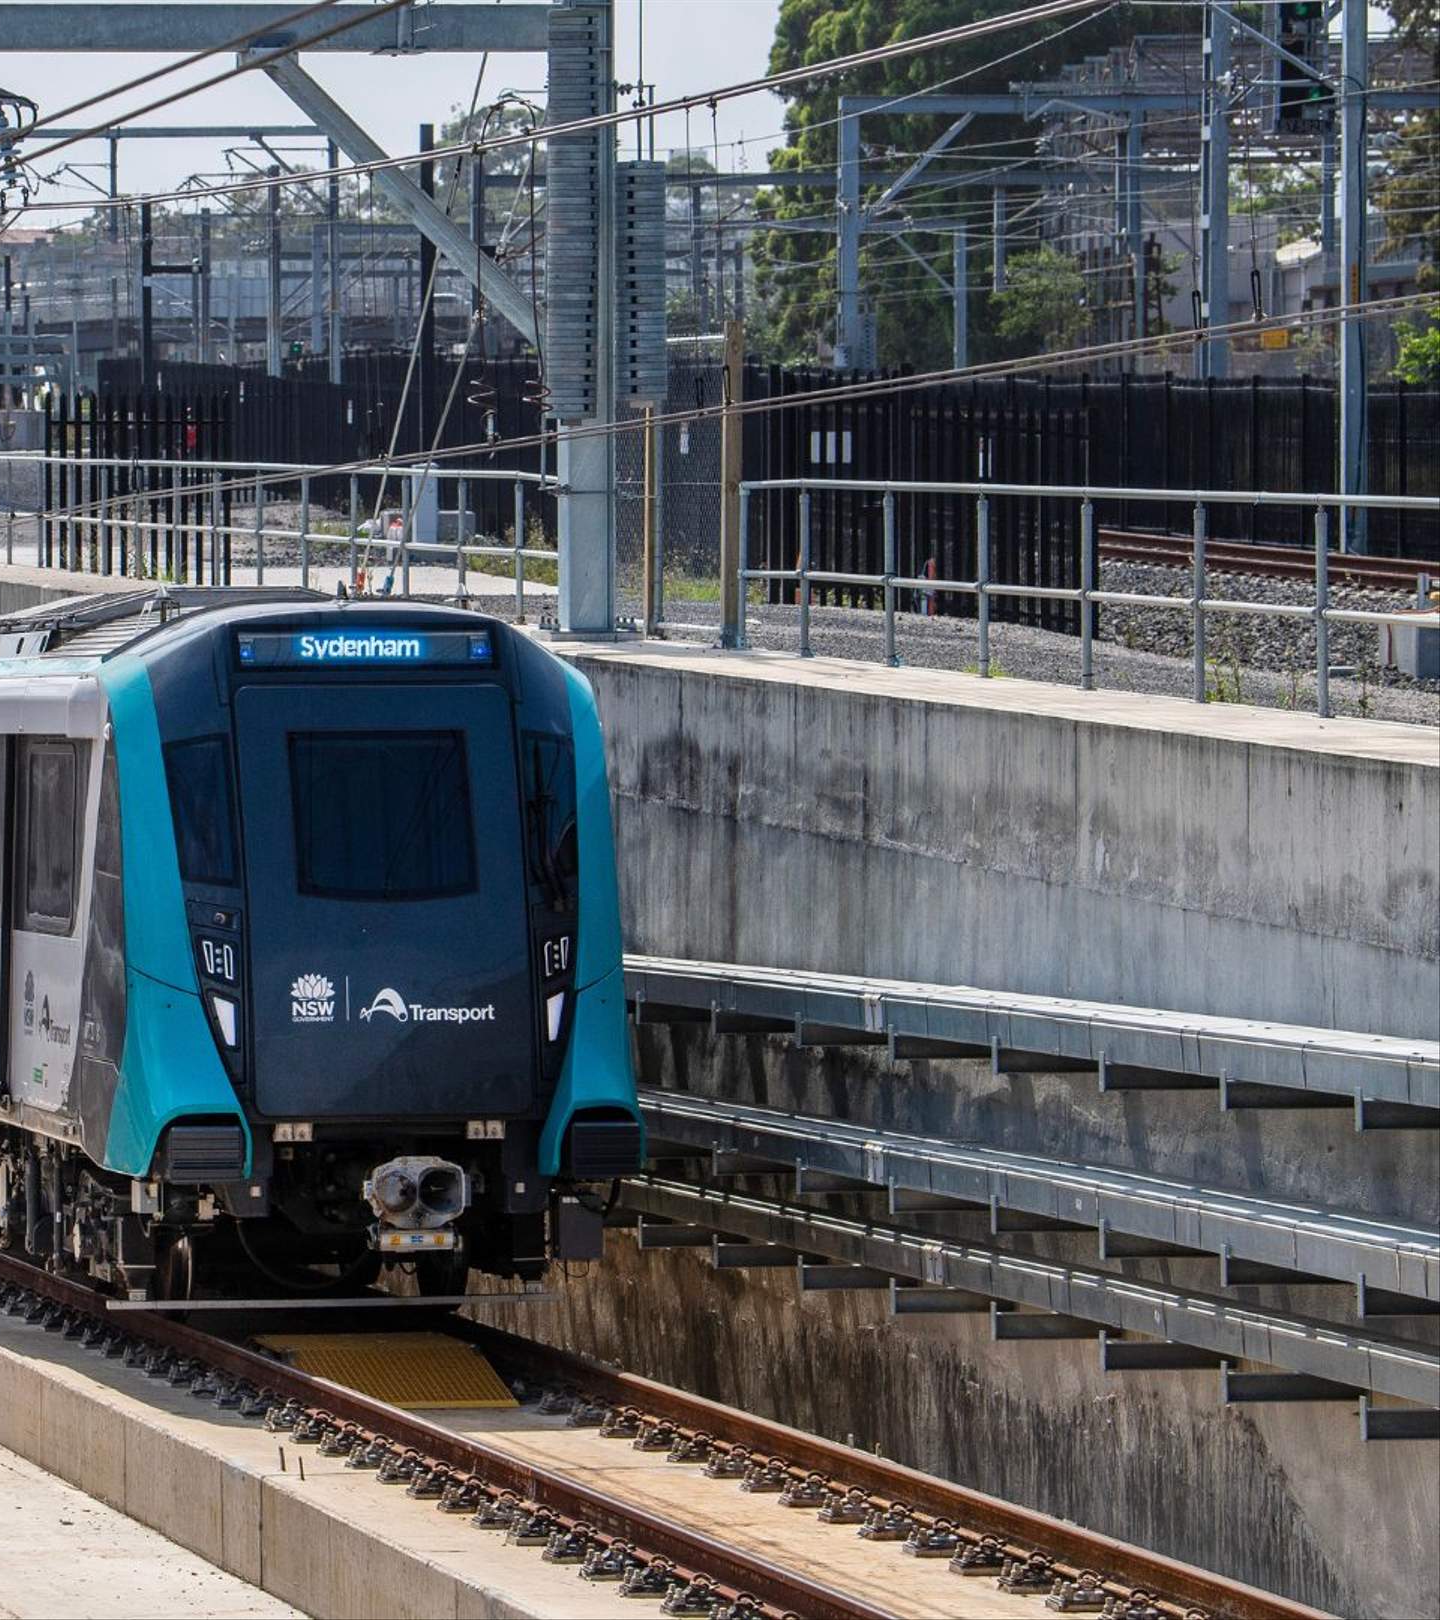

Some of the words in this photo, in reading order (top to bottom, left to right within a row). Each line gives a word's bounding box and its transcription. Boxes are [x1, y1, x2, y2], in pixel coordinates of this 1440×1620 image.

[300, 636, 420, 659] Sydenham
[292, 1001, 335, 1016] NSW
[409, 1004, 495, 1024] Transport
